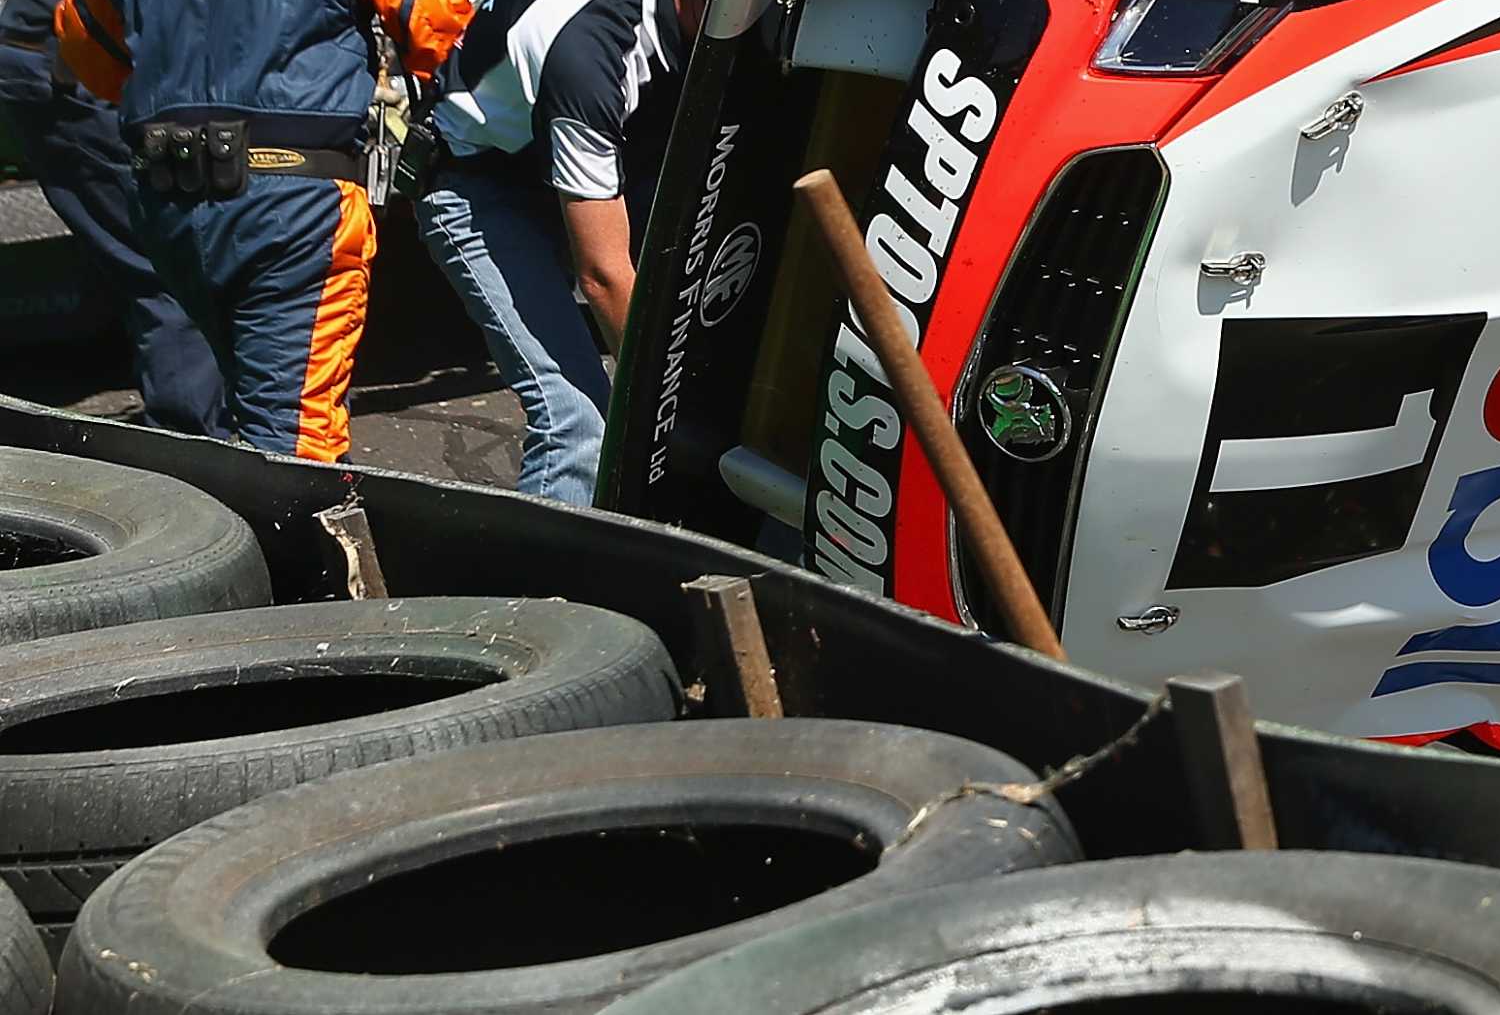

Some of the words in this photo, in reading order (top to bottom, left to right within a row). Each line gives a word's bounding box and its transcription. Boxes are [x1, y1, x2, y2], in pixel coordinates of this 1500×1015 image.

[684, 123, 741, 276] MORRIS
[652, 277, 703, 443] FINANCE
[647, 445, 670, 486] Ltd
[1209, 387, 1436, 493] 1
